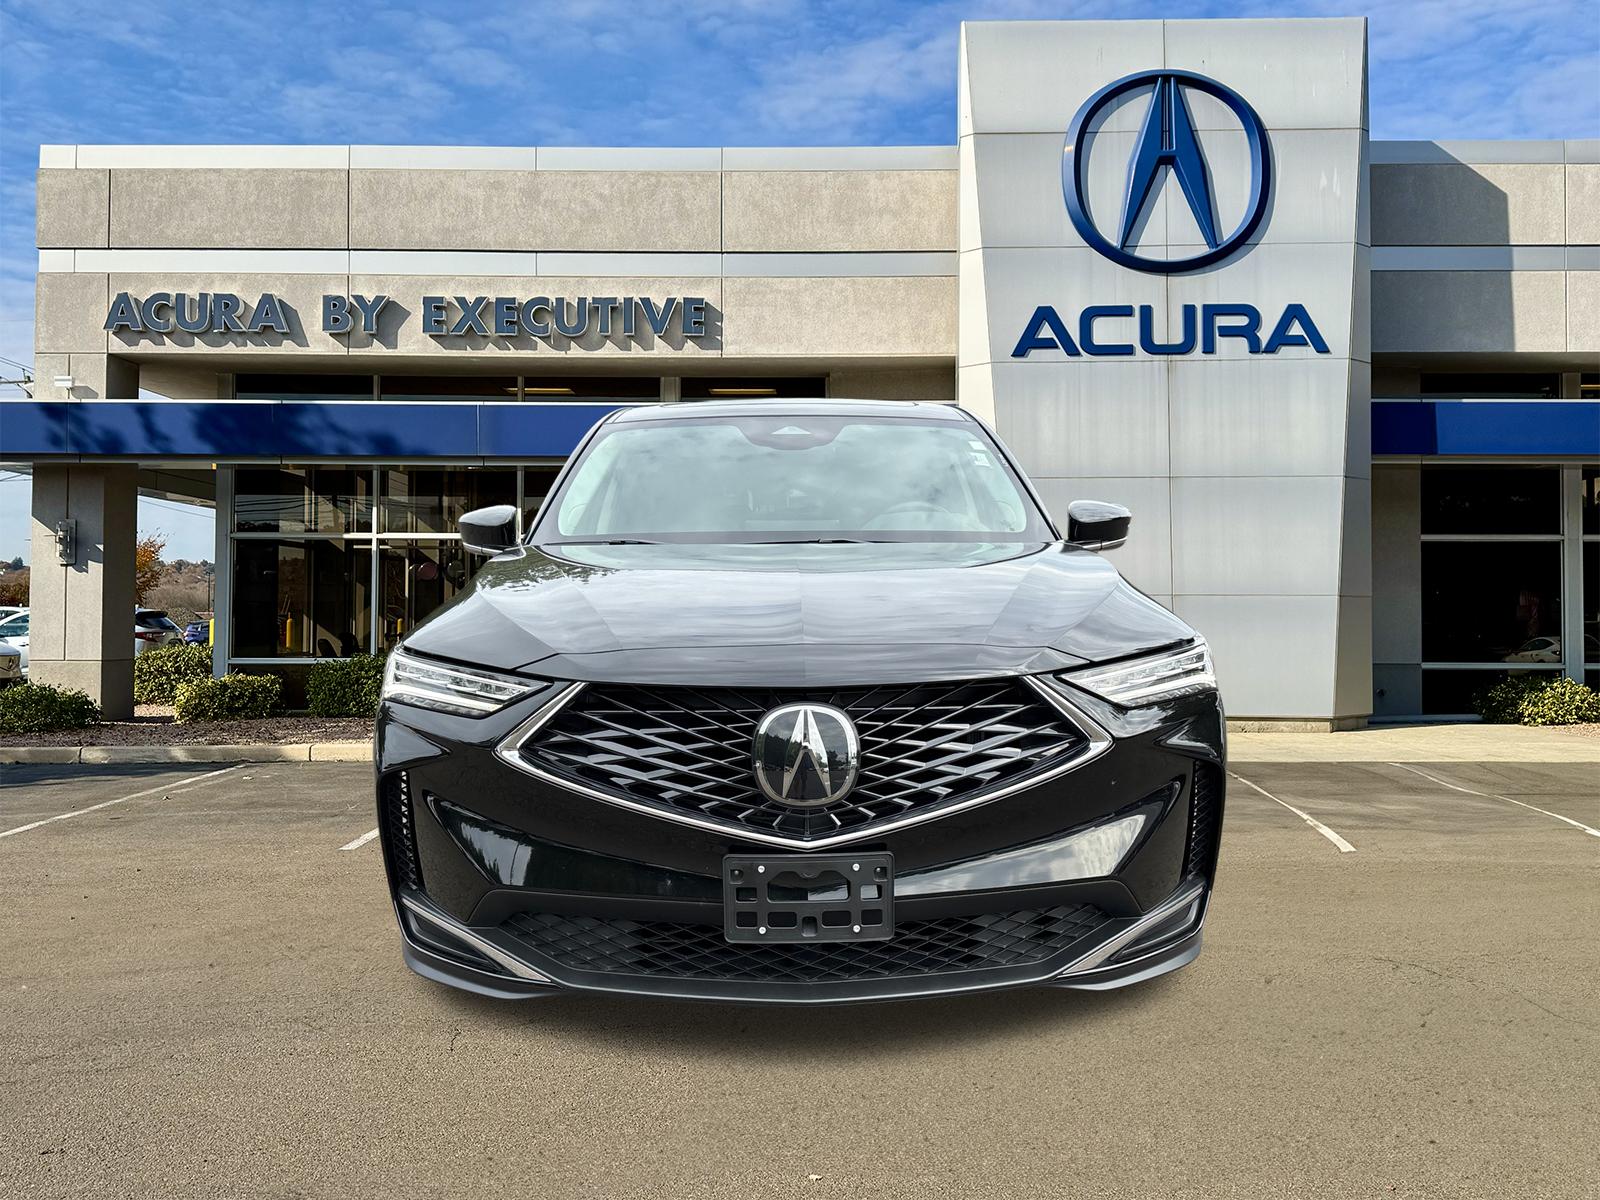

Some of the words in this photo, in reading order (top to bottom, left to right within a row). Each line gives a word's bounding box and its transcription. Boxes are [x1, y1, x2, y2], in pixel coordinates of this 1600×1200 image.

[103, 292, 290, 333] ACURA
[321, 294, 390, 335] BY
[421, 296, 707, 337] EXECUTIVE
[1011, 303, 1331, 357] ACURA
